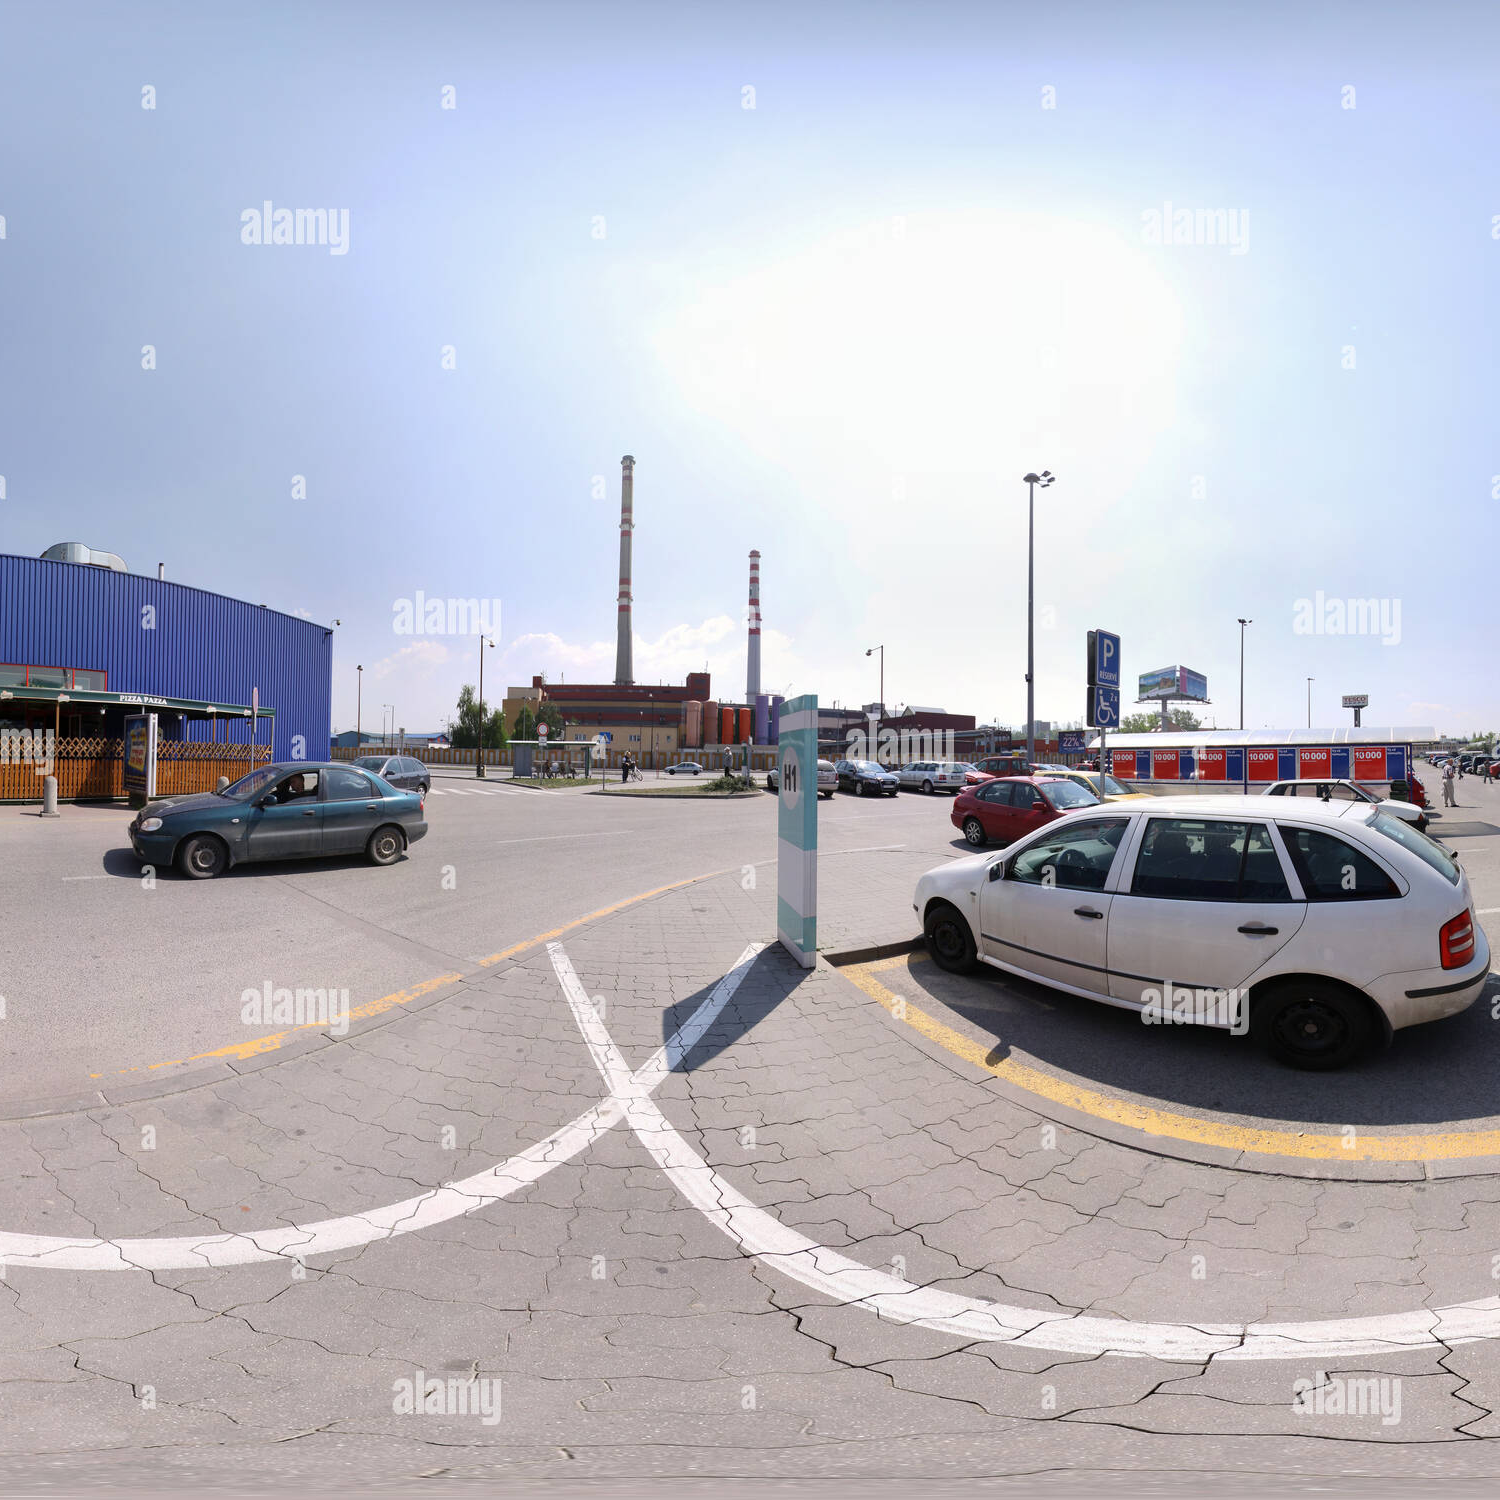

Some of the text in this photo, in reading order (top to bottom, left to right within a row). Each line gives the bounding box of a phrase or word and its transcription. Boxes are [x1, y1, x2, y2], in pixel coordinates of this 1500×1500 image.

[1104, 639, 1114, 667] P
[119, 695, 167, 705] PIZZA PAZZA
[1063, 737, 1080, 746] 22%
[1258, 753, 1274, 761] 000
[1310, 752, 1326, 760] 000
[1365, 751, 1382, 759] 000
[784, 764, 796, 792] H1
